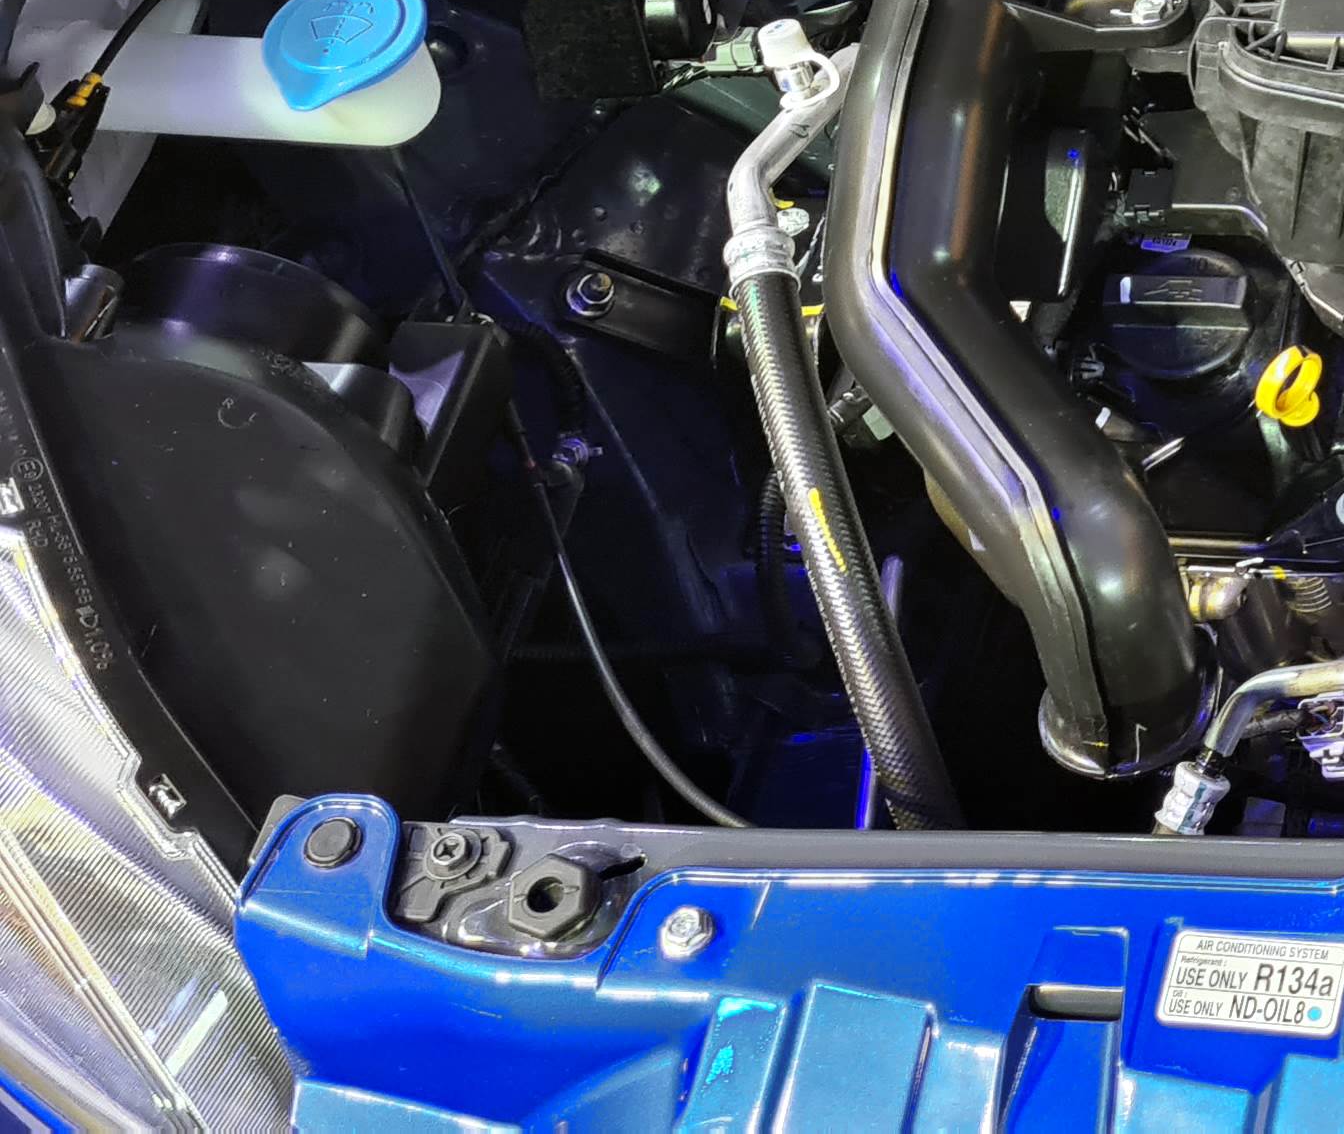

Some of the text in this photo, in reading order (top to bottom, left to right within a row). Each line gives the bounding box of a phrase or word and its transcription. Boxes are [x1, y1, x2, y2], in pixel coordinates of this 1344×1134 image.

[1196, 939, 1329, 960] AIR CONDITIONING SYSTEM
[1176, 962, 1334, 997] USE ONLY R134a
[1169, 994, 1306, 1024] USE ONLY ND-OIL8
